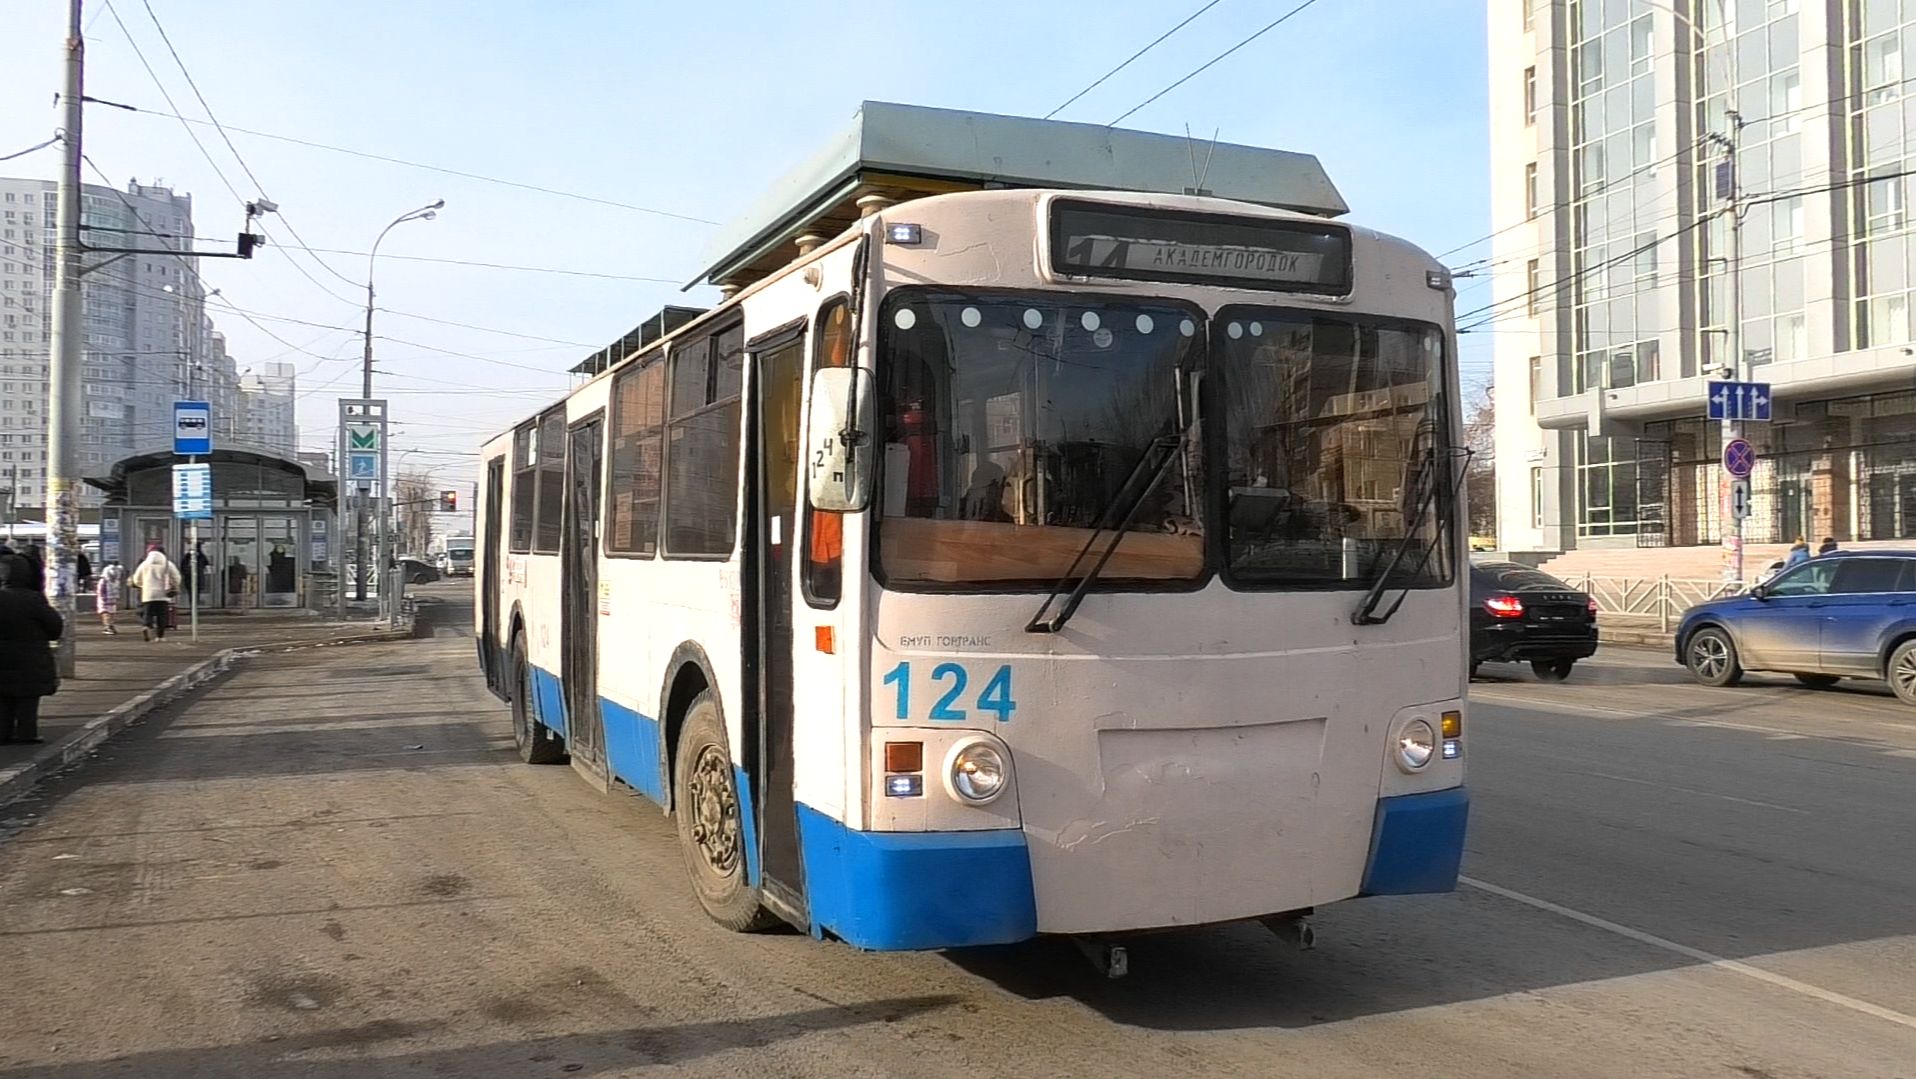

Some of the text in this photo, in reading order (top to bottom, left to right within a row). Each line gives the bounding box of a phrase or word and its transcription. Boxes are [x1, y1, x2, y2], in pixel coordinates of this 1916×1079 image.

[1153, 248, 1299, 273] АКАДЕМГОРОДОК
[900, 636, 931, 646] ЕМУП
[883, 662, 1016, 721] 124
